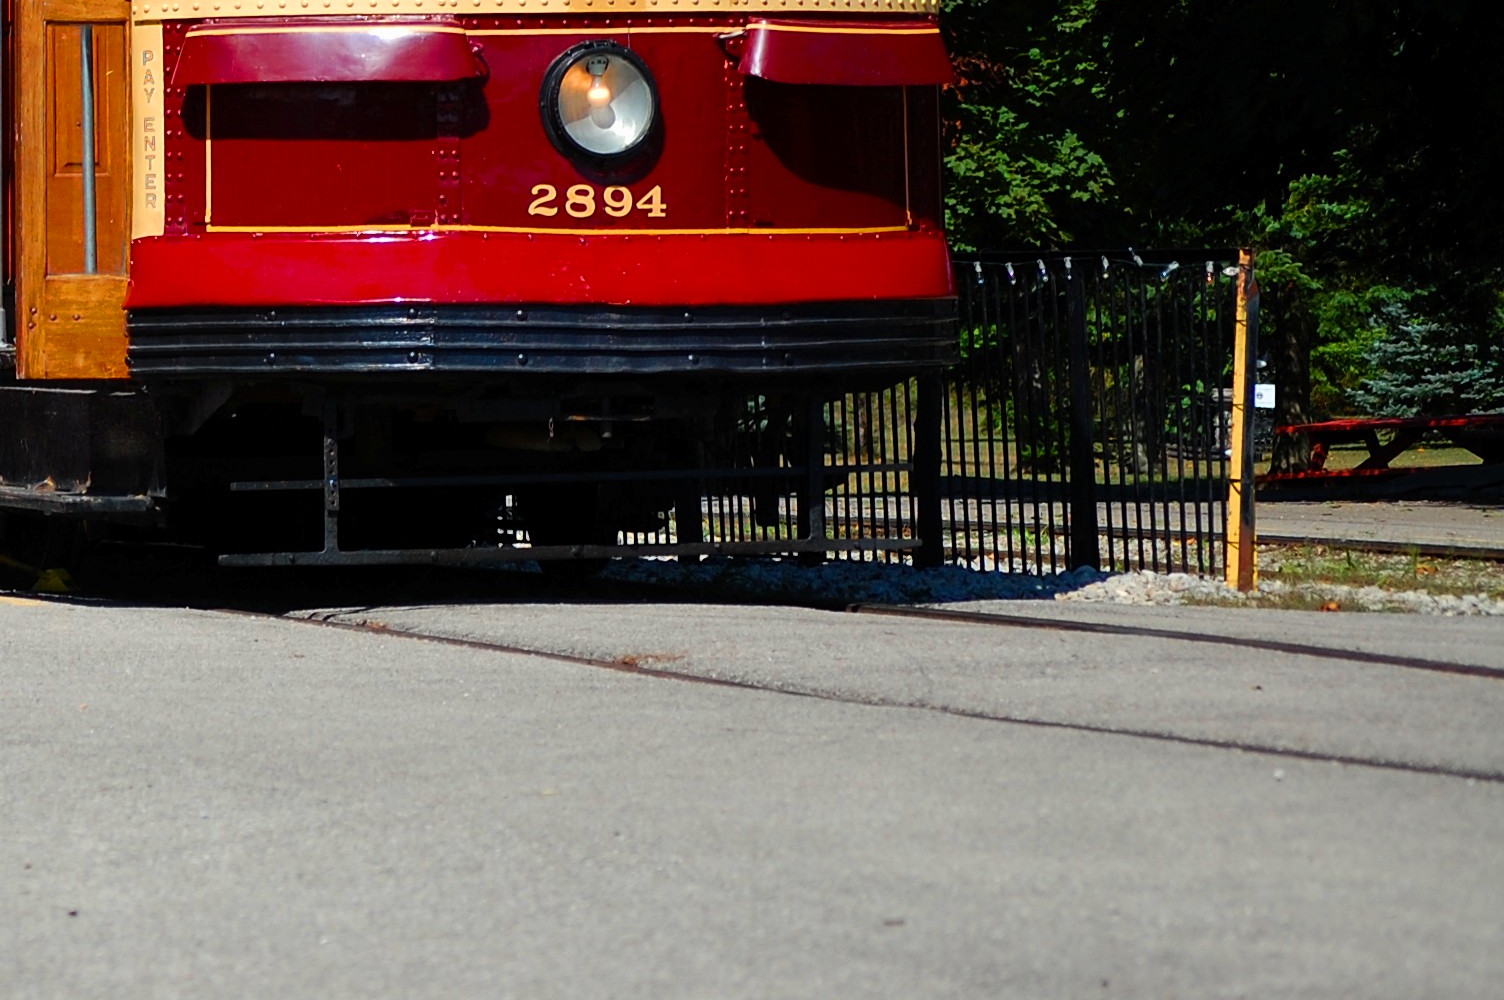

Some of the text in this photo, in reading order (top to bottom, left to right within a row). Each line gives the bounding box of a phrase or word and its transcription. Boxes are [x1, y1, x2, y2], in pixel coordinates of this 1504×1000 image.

[142, 49, 158, 210] PAY ENTER
[527, 183, 667, 219] 2894
